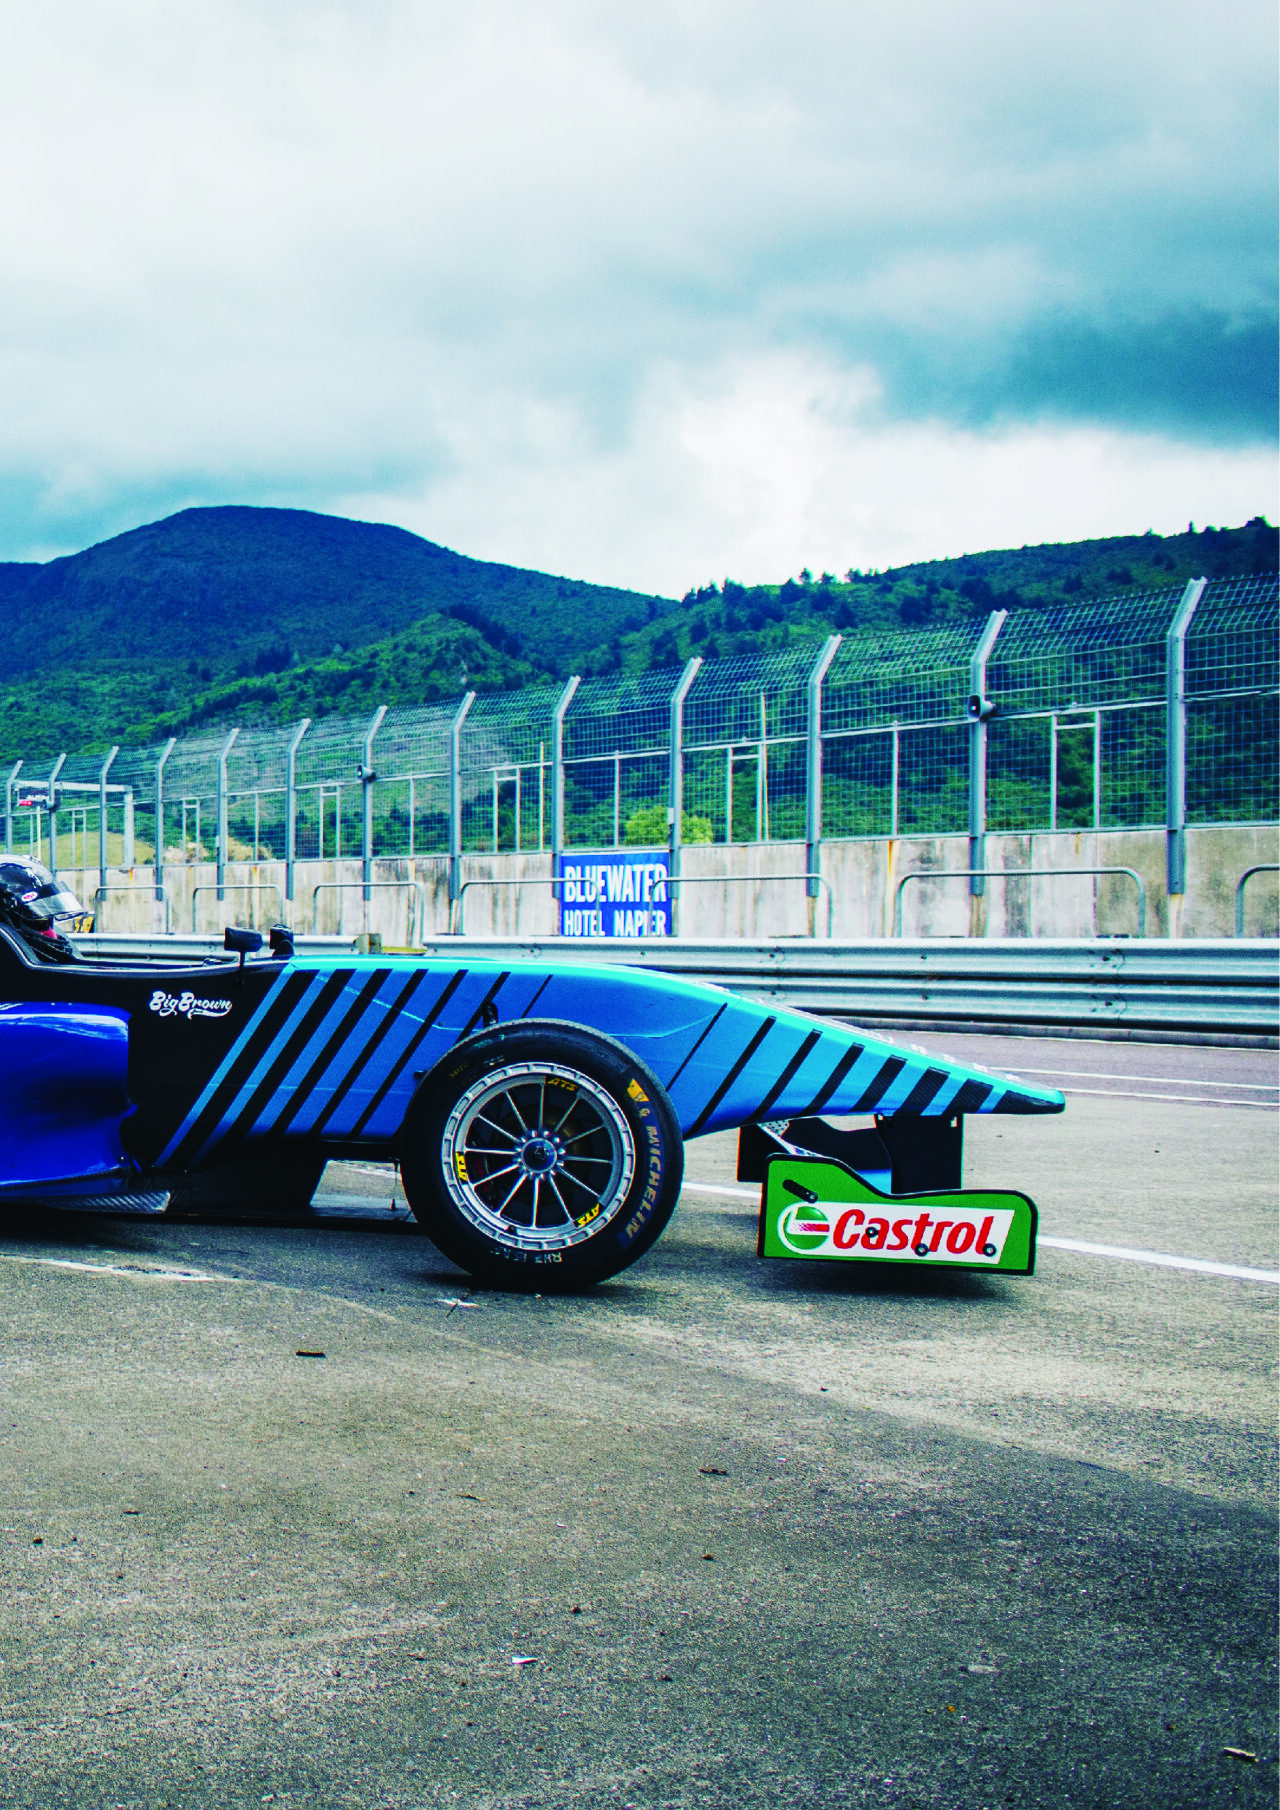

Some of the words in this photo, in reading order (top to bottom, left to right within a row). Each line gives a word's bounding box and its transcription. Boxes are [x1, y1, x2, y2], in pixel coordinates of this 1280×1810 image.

[564, 863, 668, 903] BLUEWATER
[564, 909, 606, 937] HOTEL
[614, 909, 667, 937] NAPIER
[548, 1077, 580, 1092] ATS
[624, 1125, 662, 1239] MICHELIN
[577, 1203, 601, 1227] ATS
[832, 1209, 995, 1256] Castrol
